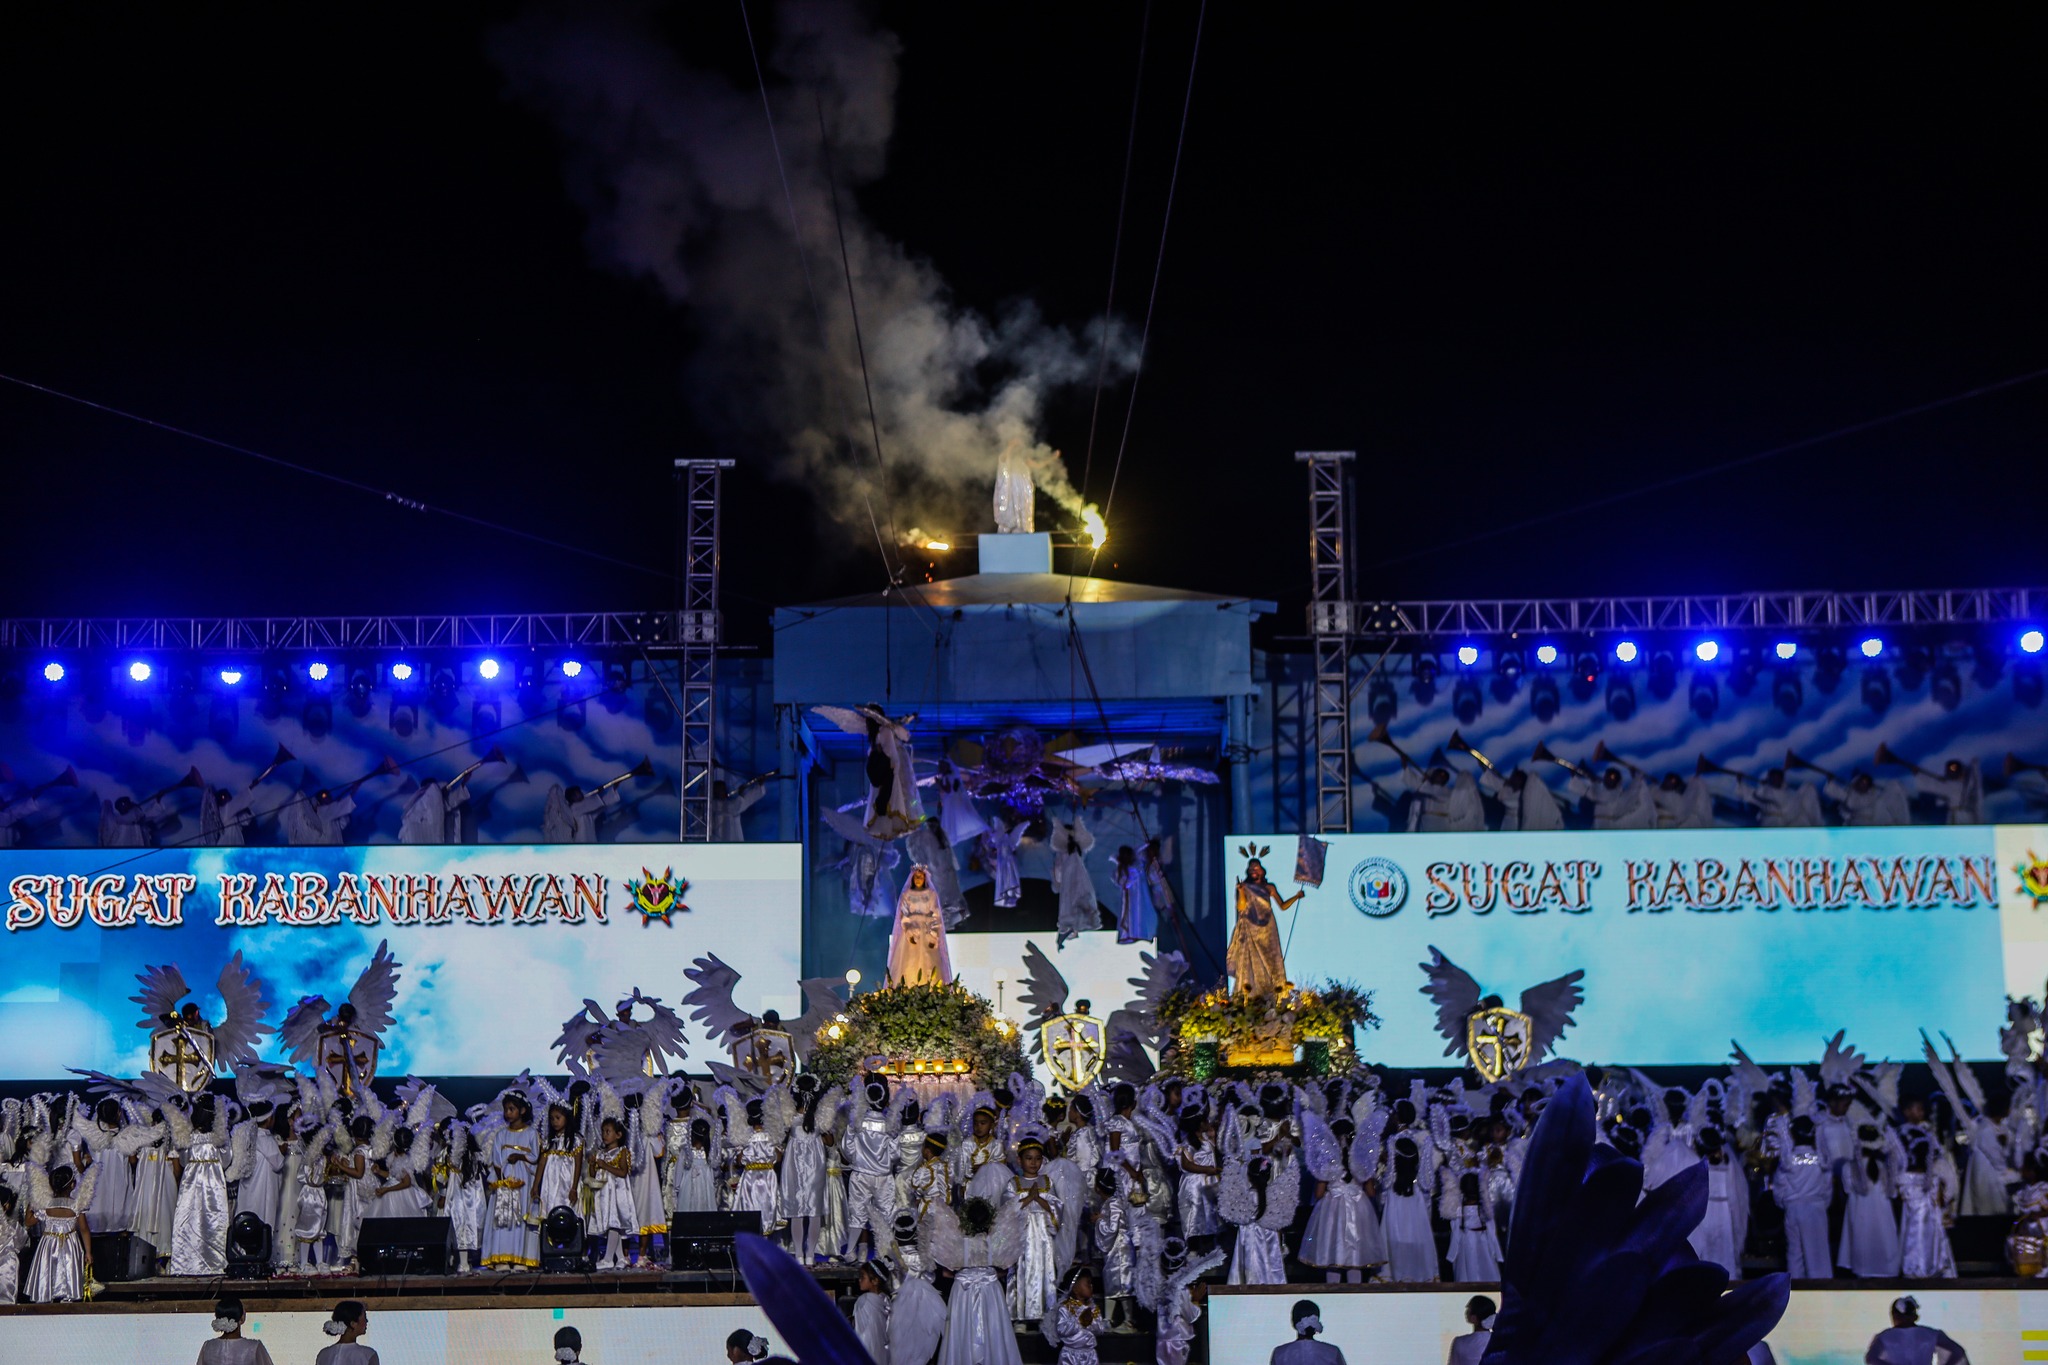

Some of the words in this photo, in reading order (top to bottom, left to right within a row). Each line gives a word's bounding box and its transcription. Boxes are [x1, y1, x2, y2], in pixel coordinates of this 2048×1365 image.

[7, 874, 195, 930] SUGAT
[216, 872, 607, 926] KABANHAWAN
[1425, 859, 1601, 918] SUGAT
[1624, 855, 2000, 912] KABANHAWAN
